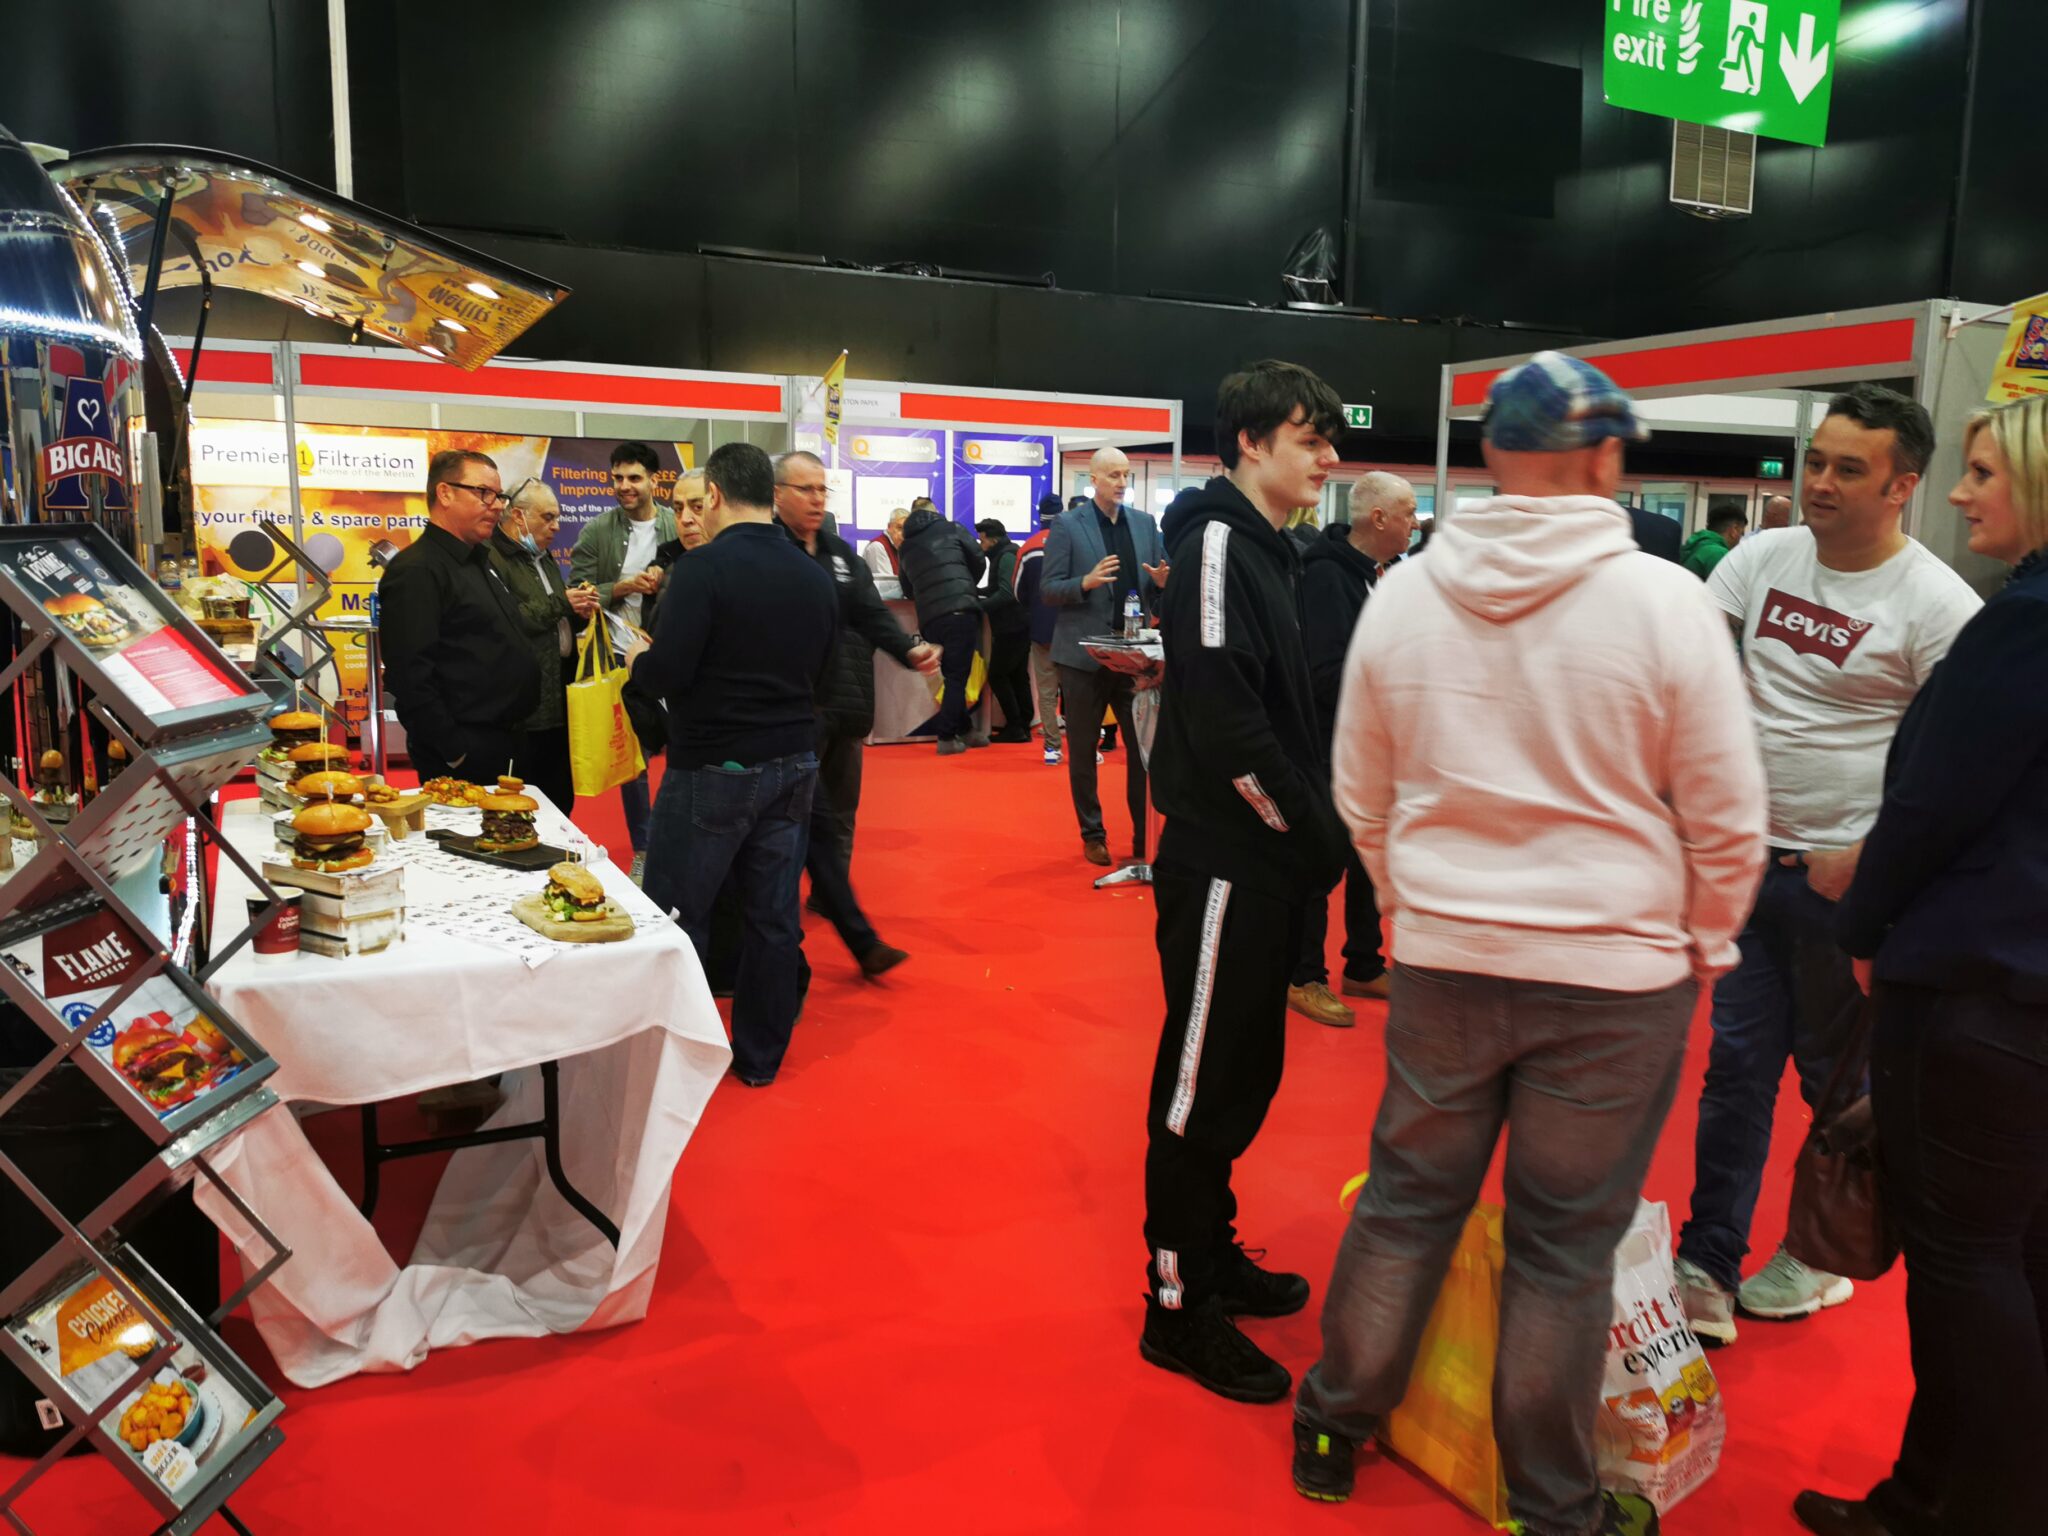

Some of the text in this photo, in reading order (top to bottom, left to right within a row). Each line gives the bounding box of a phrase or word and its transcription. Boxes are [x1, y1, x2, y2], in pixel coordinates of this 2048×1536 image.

[1612, 32, 1667, 71] exit
[49, 442, 123, 477] BIG AL'S
[201, 444, 290, 464] Premier
[317, 449, 415, 470] Filtration
[318, 467, 349, 477] Home
[364, 468, 381, 477] the
[383, 469, 416, 478] Merlin
[552, 466, 608, 482] Filtering
[201, 511, 246, 527] your
[311, 511, 325, 525] &
[330, 514, 381, 528] spare
[386, 515, 429, 530] parts
[561, 503, 576, 513] Top
[578, 503, 587, 513] of
[588, 503, 602, 513] the
[1767, 604, 1852, 648] Levi's
[52, 931, 132, 982] FLAME
